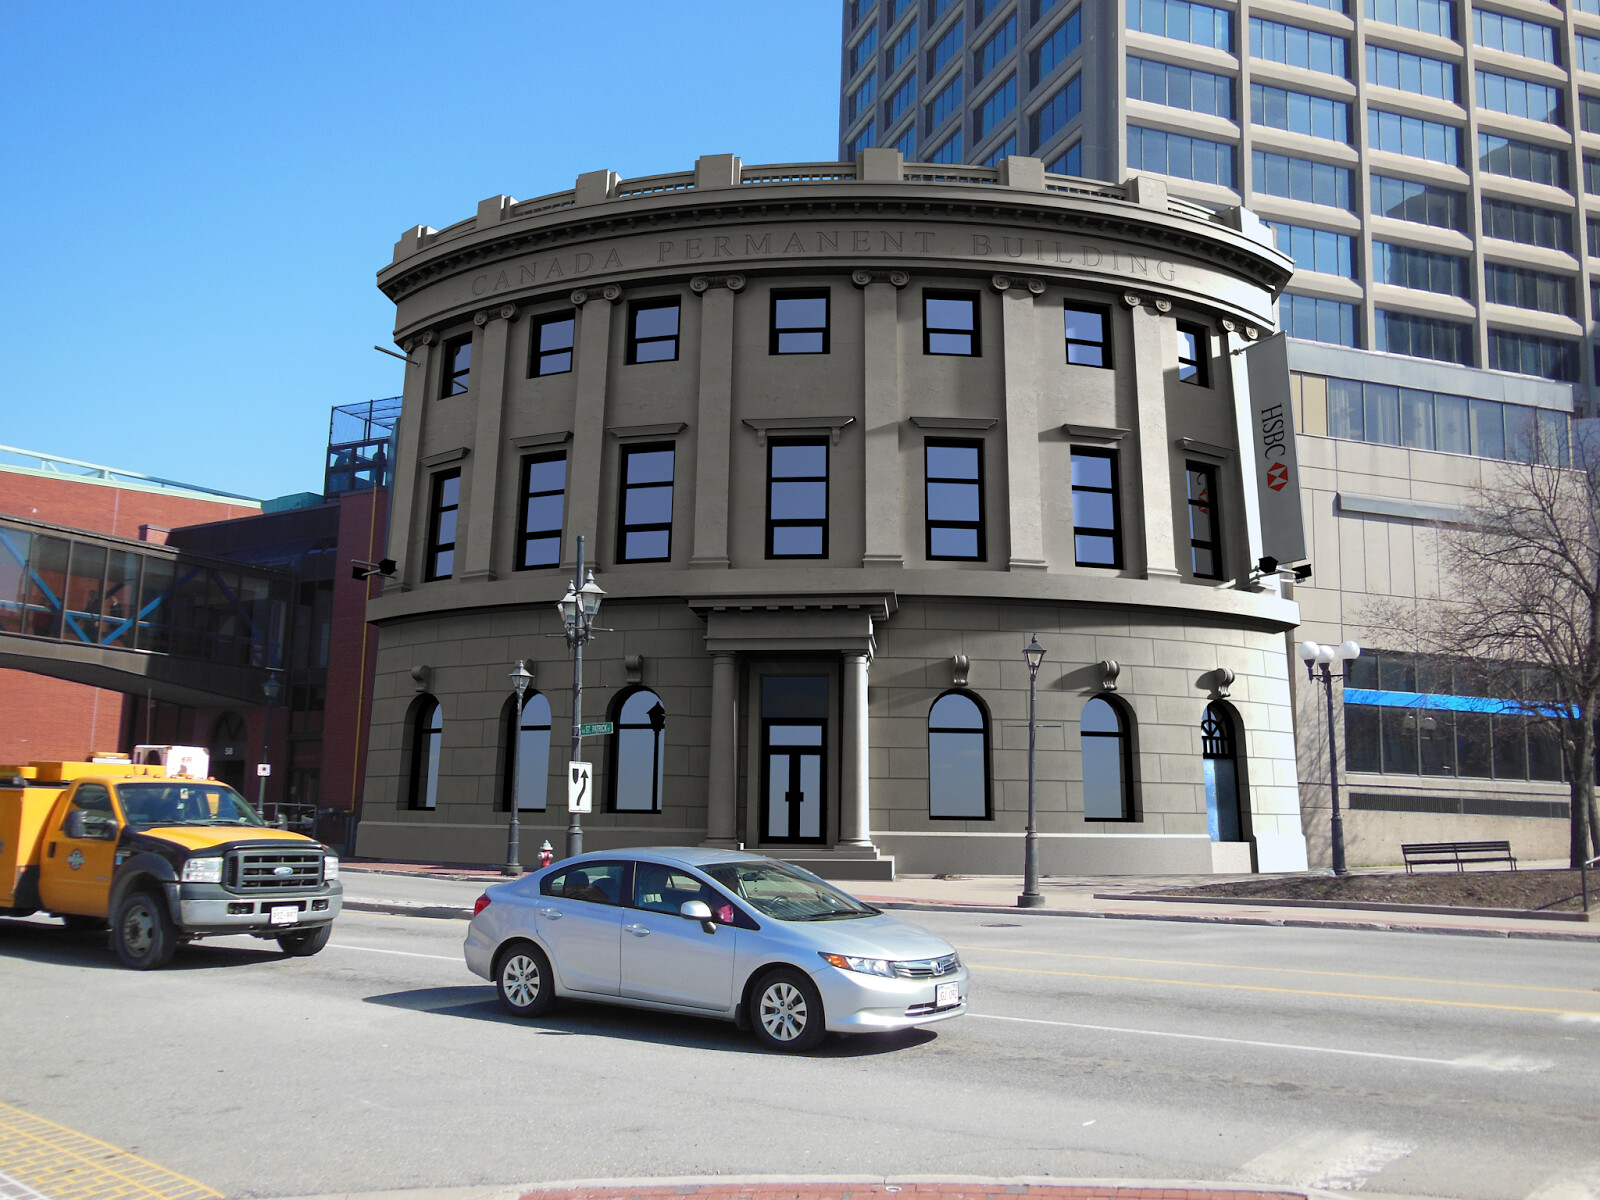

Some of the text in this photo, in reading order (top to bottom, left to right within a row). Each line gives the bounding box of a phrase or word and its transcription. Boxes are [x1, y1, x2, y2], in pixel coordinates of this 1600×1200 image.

[471, 231, 1176, 297] CANADA PERMANENT BUILDING
[1261, 403, 1286, 460] HSBC
